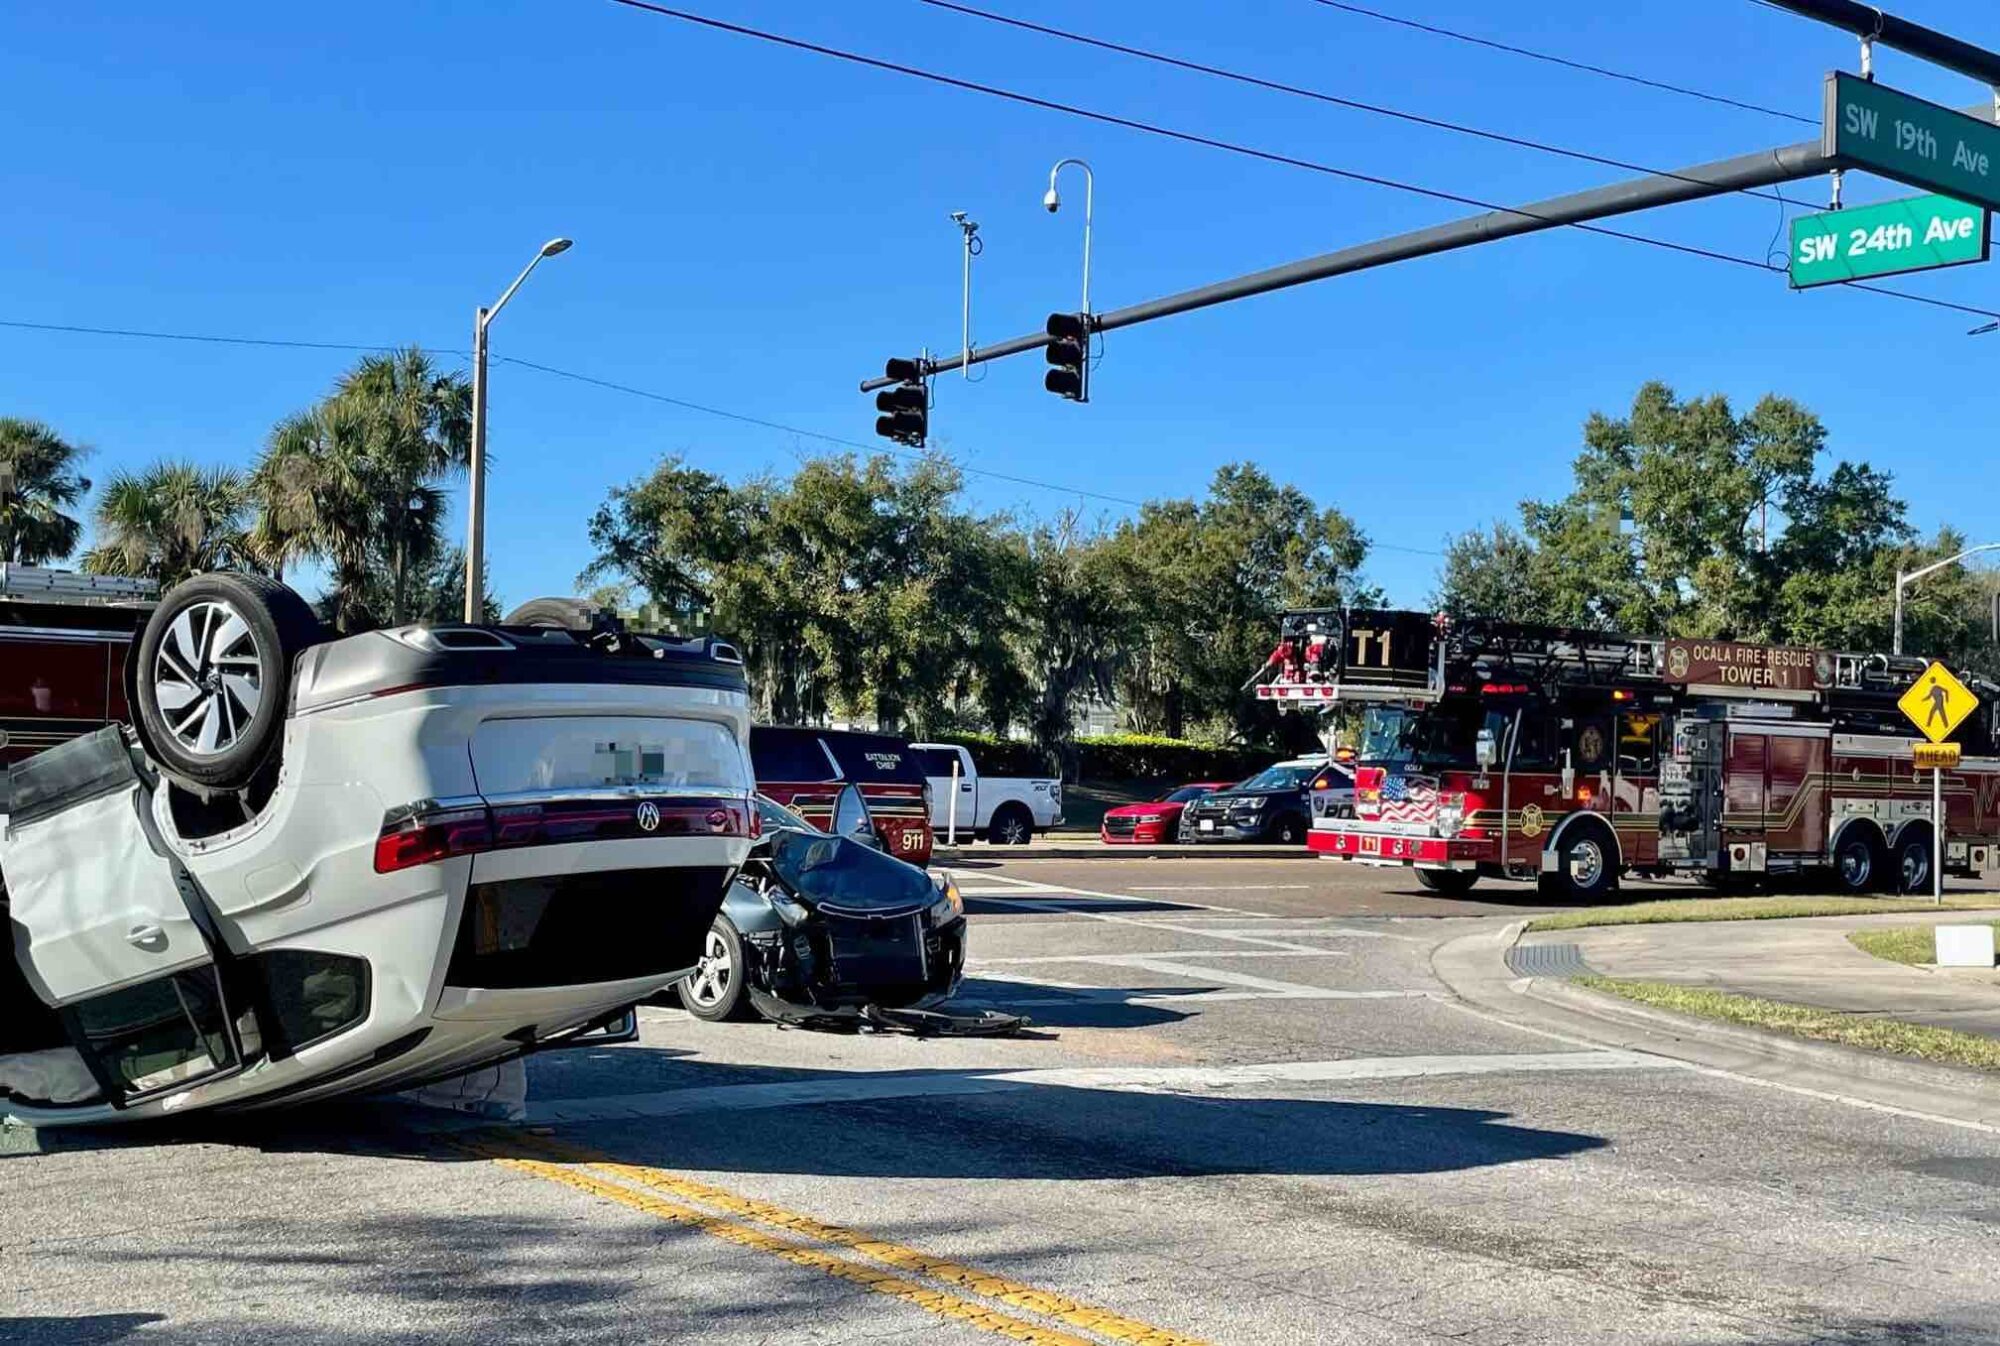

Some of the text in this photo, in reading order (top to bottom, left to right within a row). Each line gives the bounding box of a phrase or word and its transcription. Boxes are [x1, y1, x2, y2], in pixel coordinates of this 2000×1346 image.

[1845, 103, 1989, 176] SW 19th Ave
[1798, 216, 1974, 264] SW 24th Ave
[1352, 630, 1390, 666] T1
[1693, 645, 1812, 667] OCALA FIRE-RESCUE
[1718, 665, 1788, 685] TOWER 1
[1917, 749, 1957, 763] AHEAD
[902, 833, 924, 850] 911
